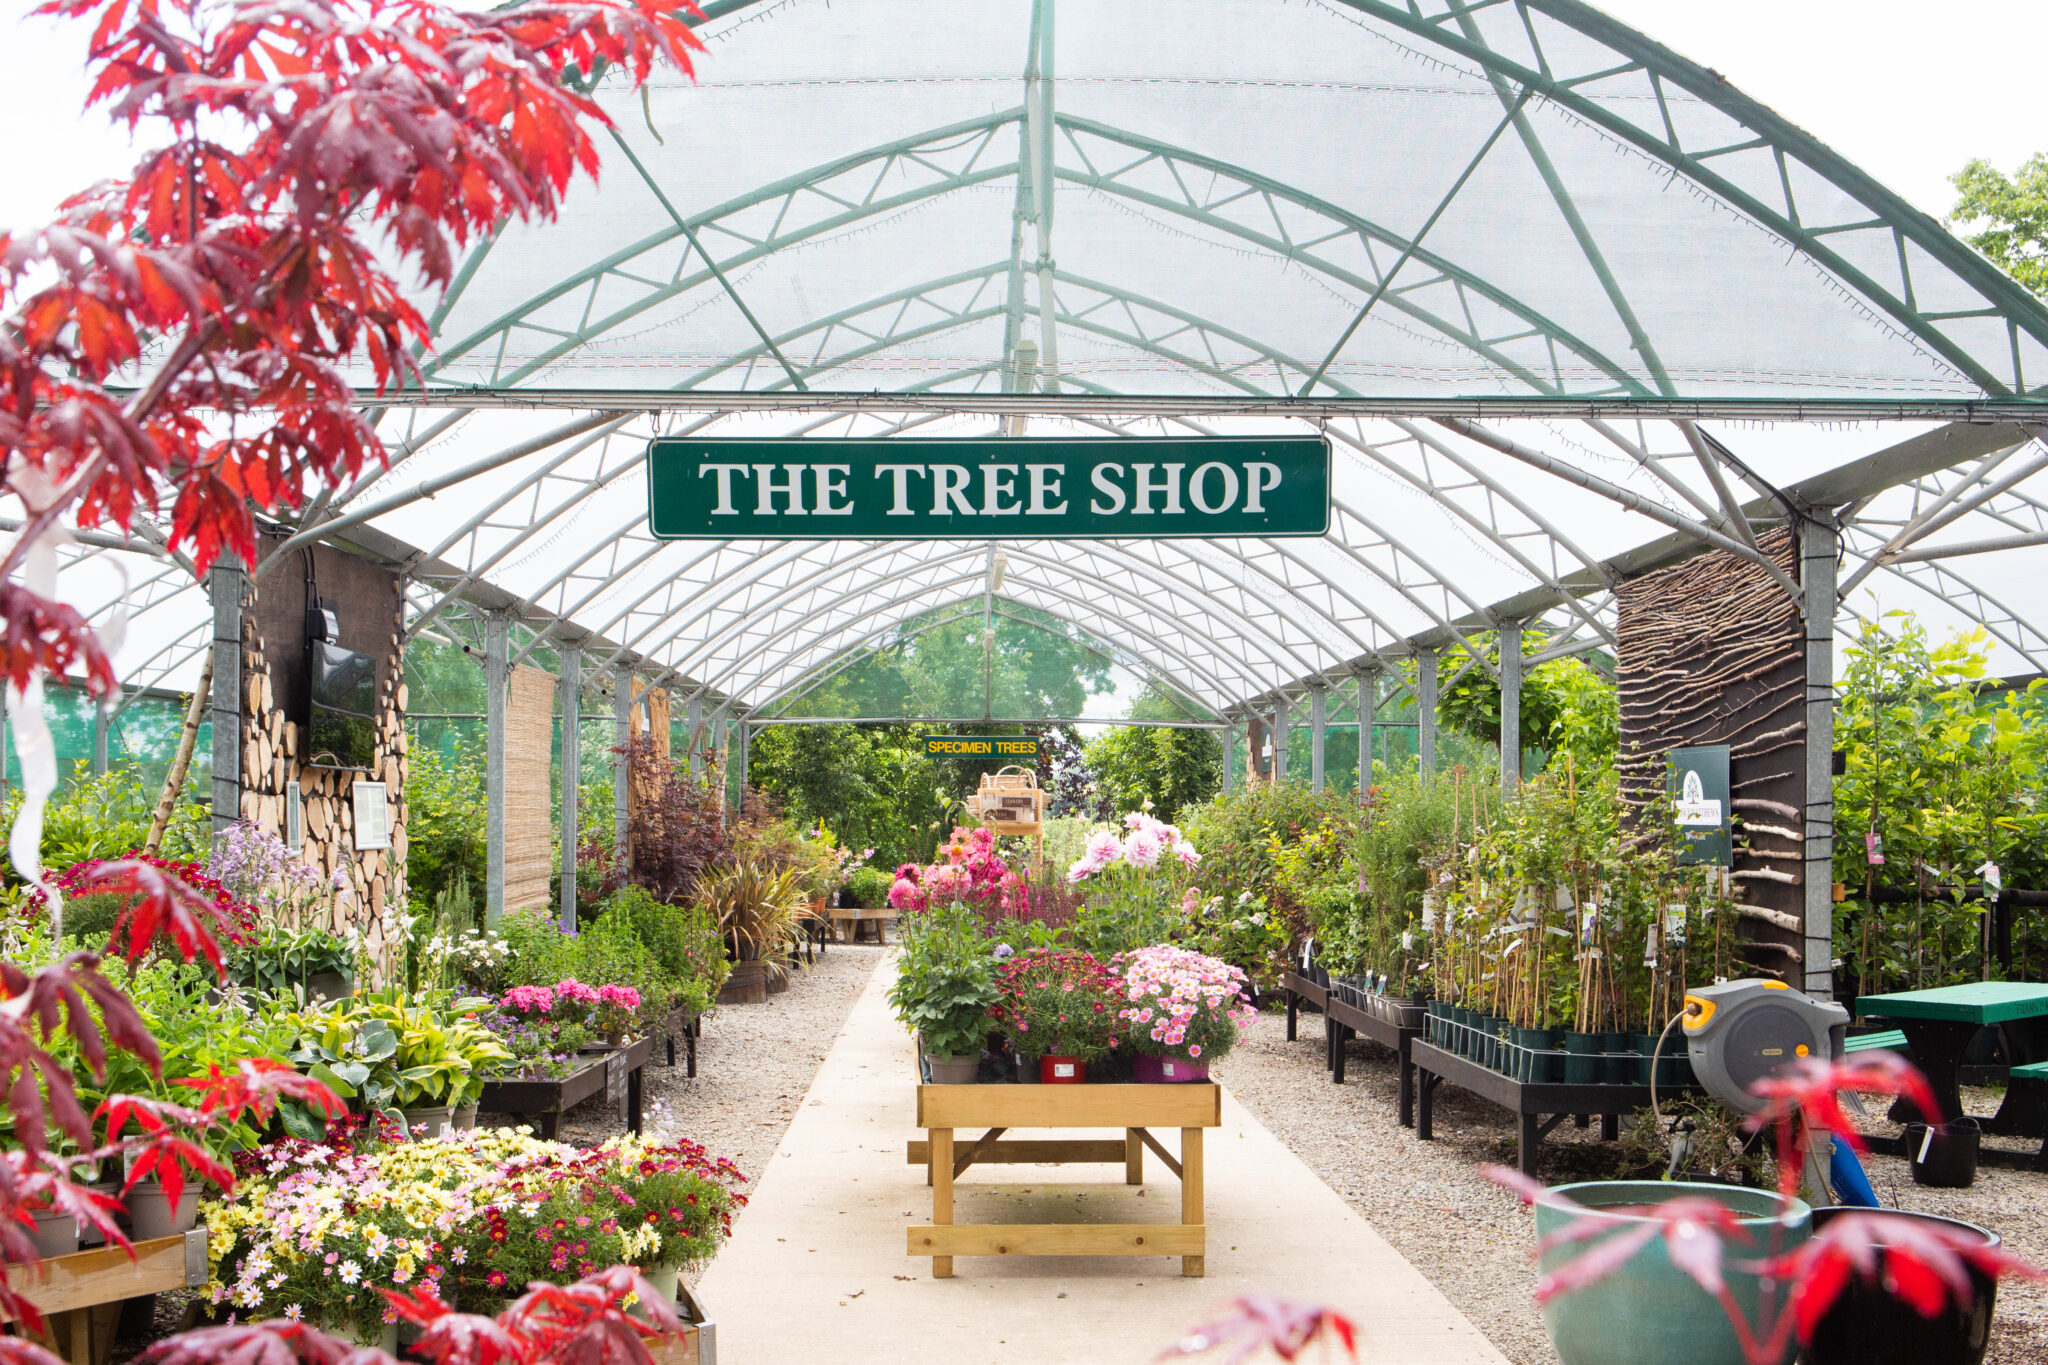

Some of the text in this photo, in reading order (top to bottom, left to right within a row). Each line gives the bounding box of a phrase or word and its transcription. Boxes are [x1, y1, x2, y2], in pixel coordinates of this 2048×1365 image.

[699, 461, 1282, 516] THE TREE SHOP
[928, 740, 1037, 754] SPECIMEN TREES
